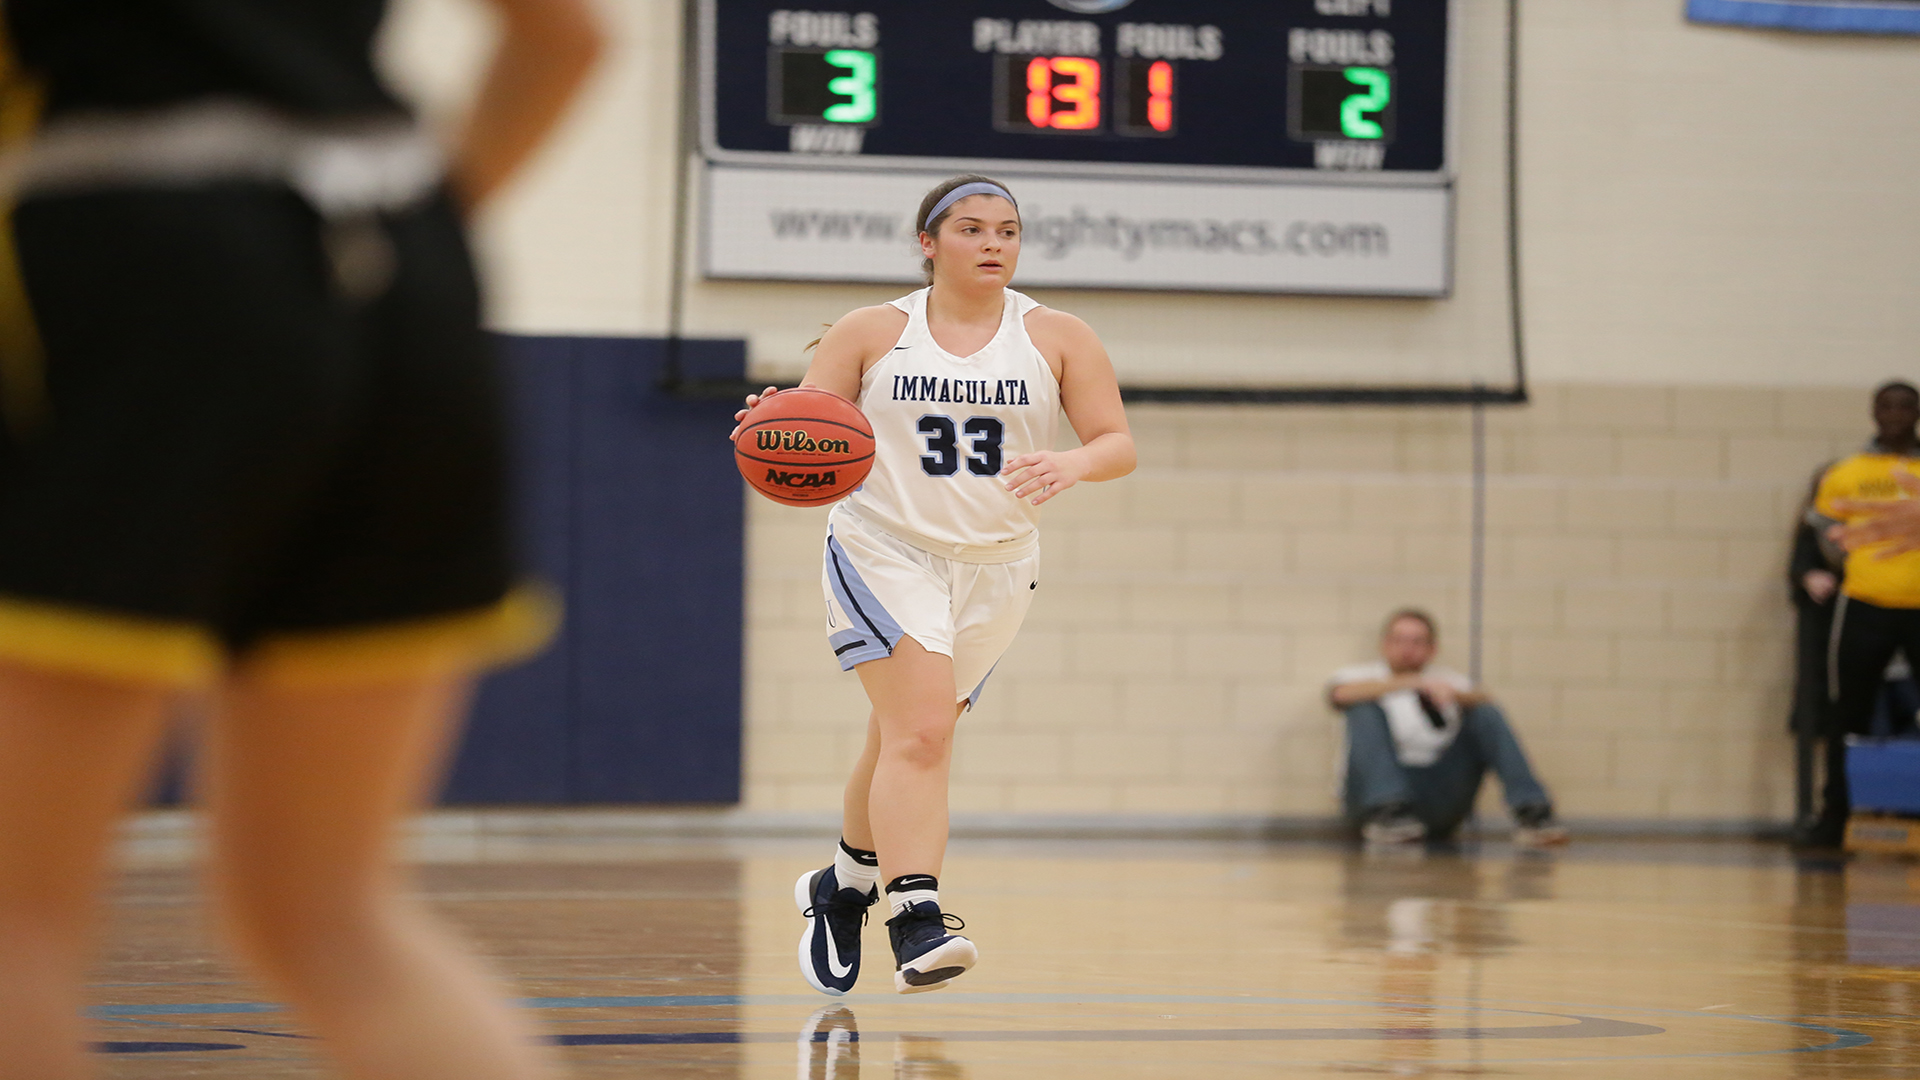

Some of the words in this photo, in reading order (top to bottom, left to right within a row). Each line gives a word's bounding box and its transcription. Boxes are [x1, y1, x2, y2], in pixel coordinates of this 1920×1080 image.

[768, 10, 879, 47] FOULS
[972, 18, 1101, 55] PLAYER
[1116, 22, 1224, 61] FOULS
[1287, 28, 1395, 65] FOULS
[823, 50, 877, 123] 3
[1026, 56, 1101, 130] 13
[1147, 60, 1173, 132] 1
[1340, 66, 1390, 139] 2
[892, 375, 1030, 405] IMMACULATA
[756, 430, 851, 454] Wilson
[916, 413, 1006, 478] 33
[765, 468, 837, 488] NCAA
